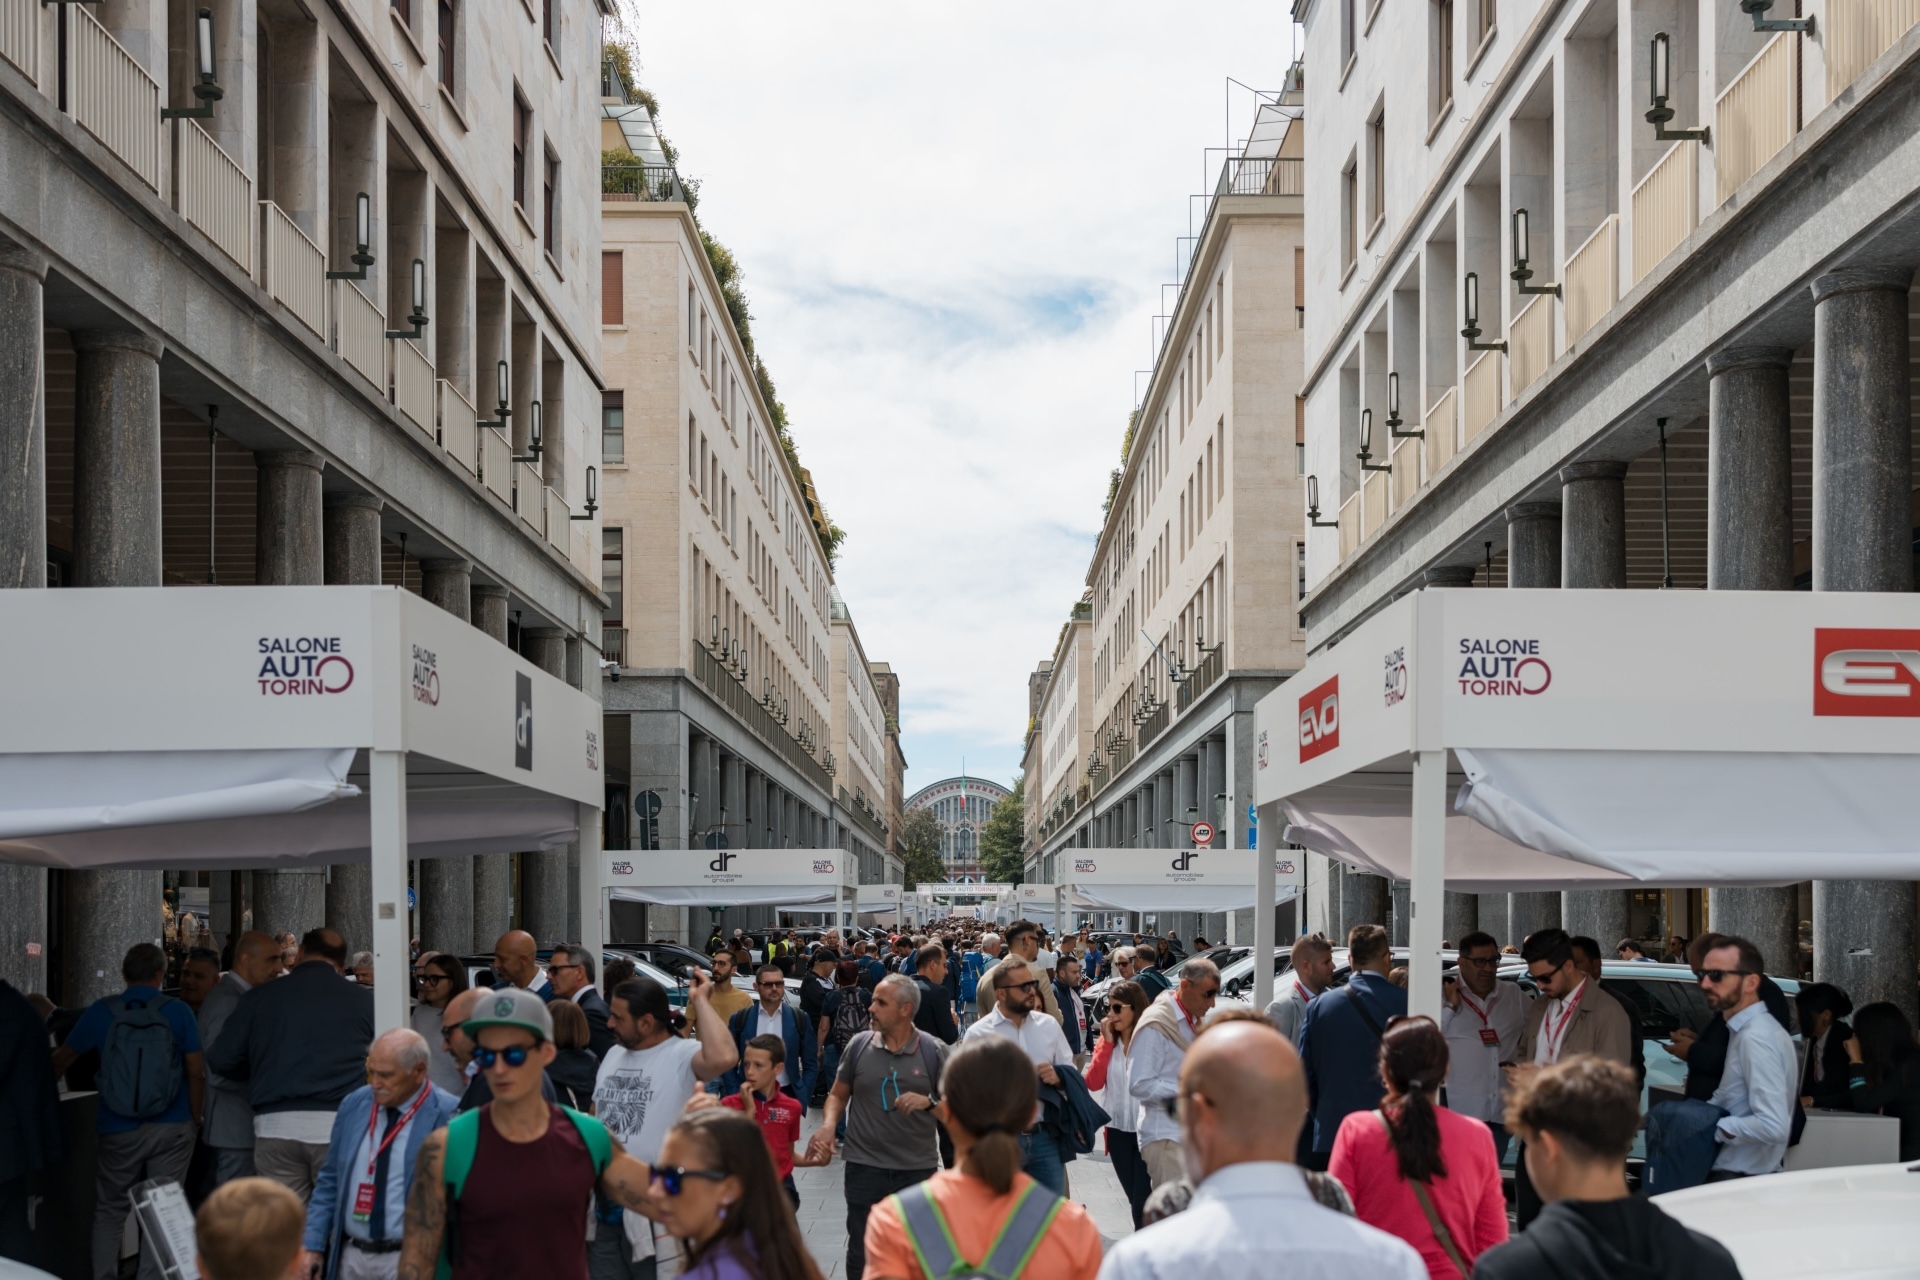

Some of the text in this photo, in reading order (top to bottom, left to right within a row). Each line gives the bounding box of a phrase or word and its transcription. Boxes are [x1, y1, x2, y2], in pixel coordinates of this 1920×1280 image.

[258, 637, 341, 653] SALONE
[412, 643, 437, 668] SALONE
[1459, 638, 1540, 655] SALONE
[1384, 646, 1404, 669] SALONE
[258, 655, 354, 694] AUTO
[412, 662, 440, 706] AUTO
[1384, 664, 1408, 701] AUTO
[1459, 656, 1552, 695] AUTO
[516, 701, 531, 749] dr
[1300, 693, 1339, 747] EVO
[612, 865, 634, 875] AUTO
[709, 852, 737, 872] dr
[812, 864, 835, 873] AUTO
[1075, 863, 1097, 873] AUTO
[1171, 851, 1199, 871] dr
[596, 1088, 654, 1102] ATLANTIC COAST
